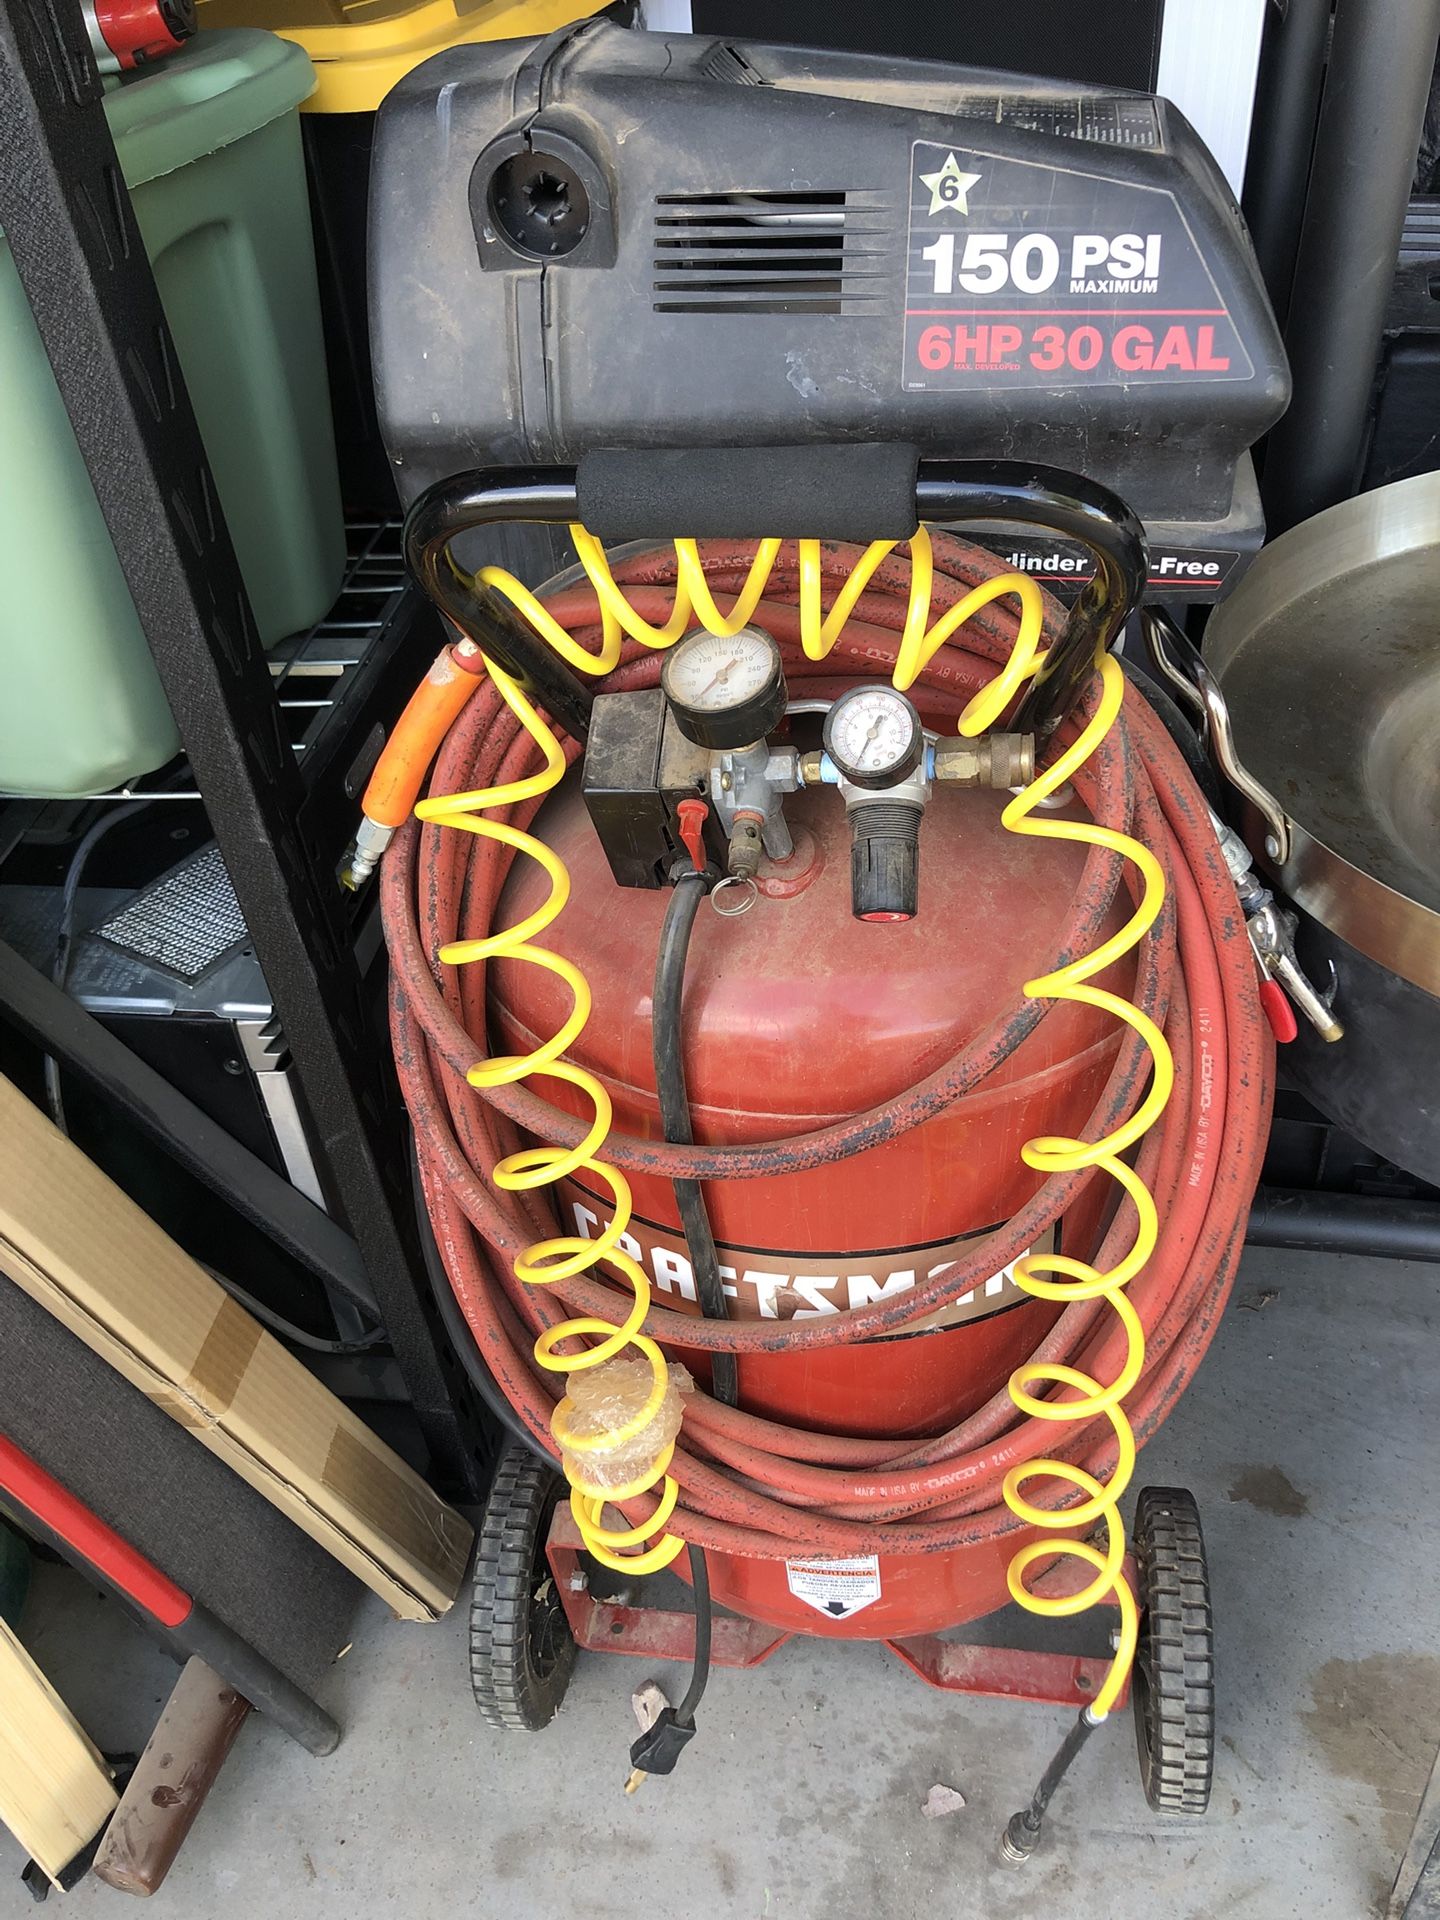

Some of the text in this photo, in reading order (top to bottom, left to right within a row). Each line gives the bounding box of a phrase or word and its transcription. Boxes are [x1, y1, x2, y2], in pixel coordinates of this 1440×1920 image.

[938, 175, 960, 202] 6
[922, 233, 1163, 294] 150 PSI
[1069, 280, 1159, 295] MAXIMUM
[918, 325, 1230, 371] 6HP 30 GAL
[975, 362, 1021, 371] DEVELOPED
[937, 665, 951, 679] BY
[955, 672, 974, 685] USA
[1188, 1007, 1213, 1188] MADE IN USA BY DAYCO 2411
[854, 1447, 1017, 1497] MADE IN USA BY DAYCO 2411
[800, 1567, 874, 1577] ADVERTENCIA
